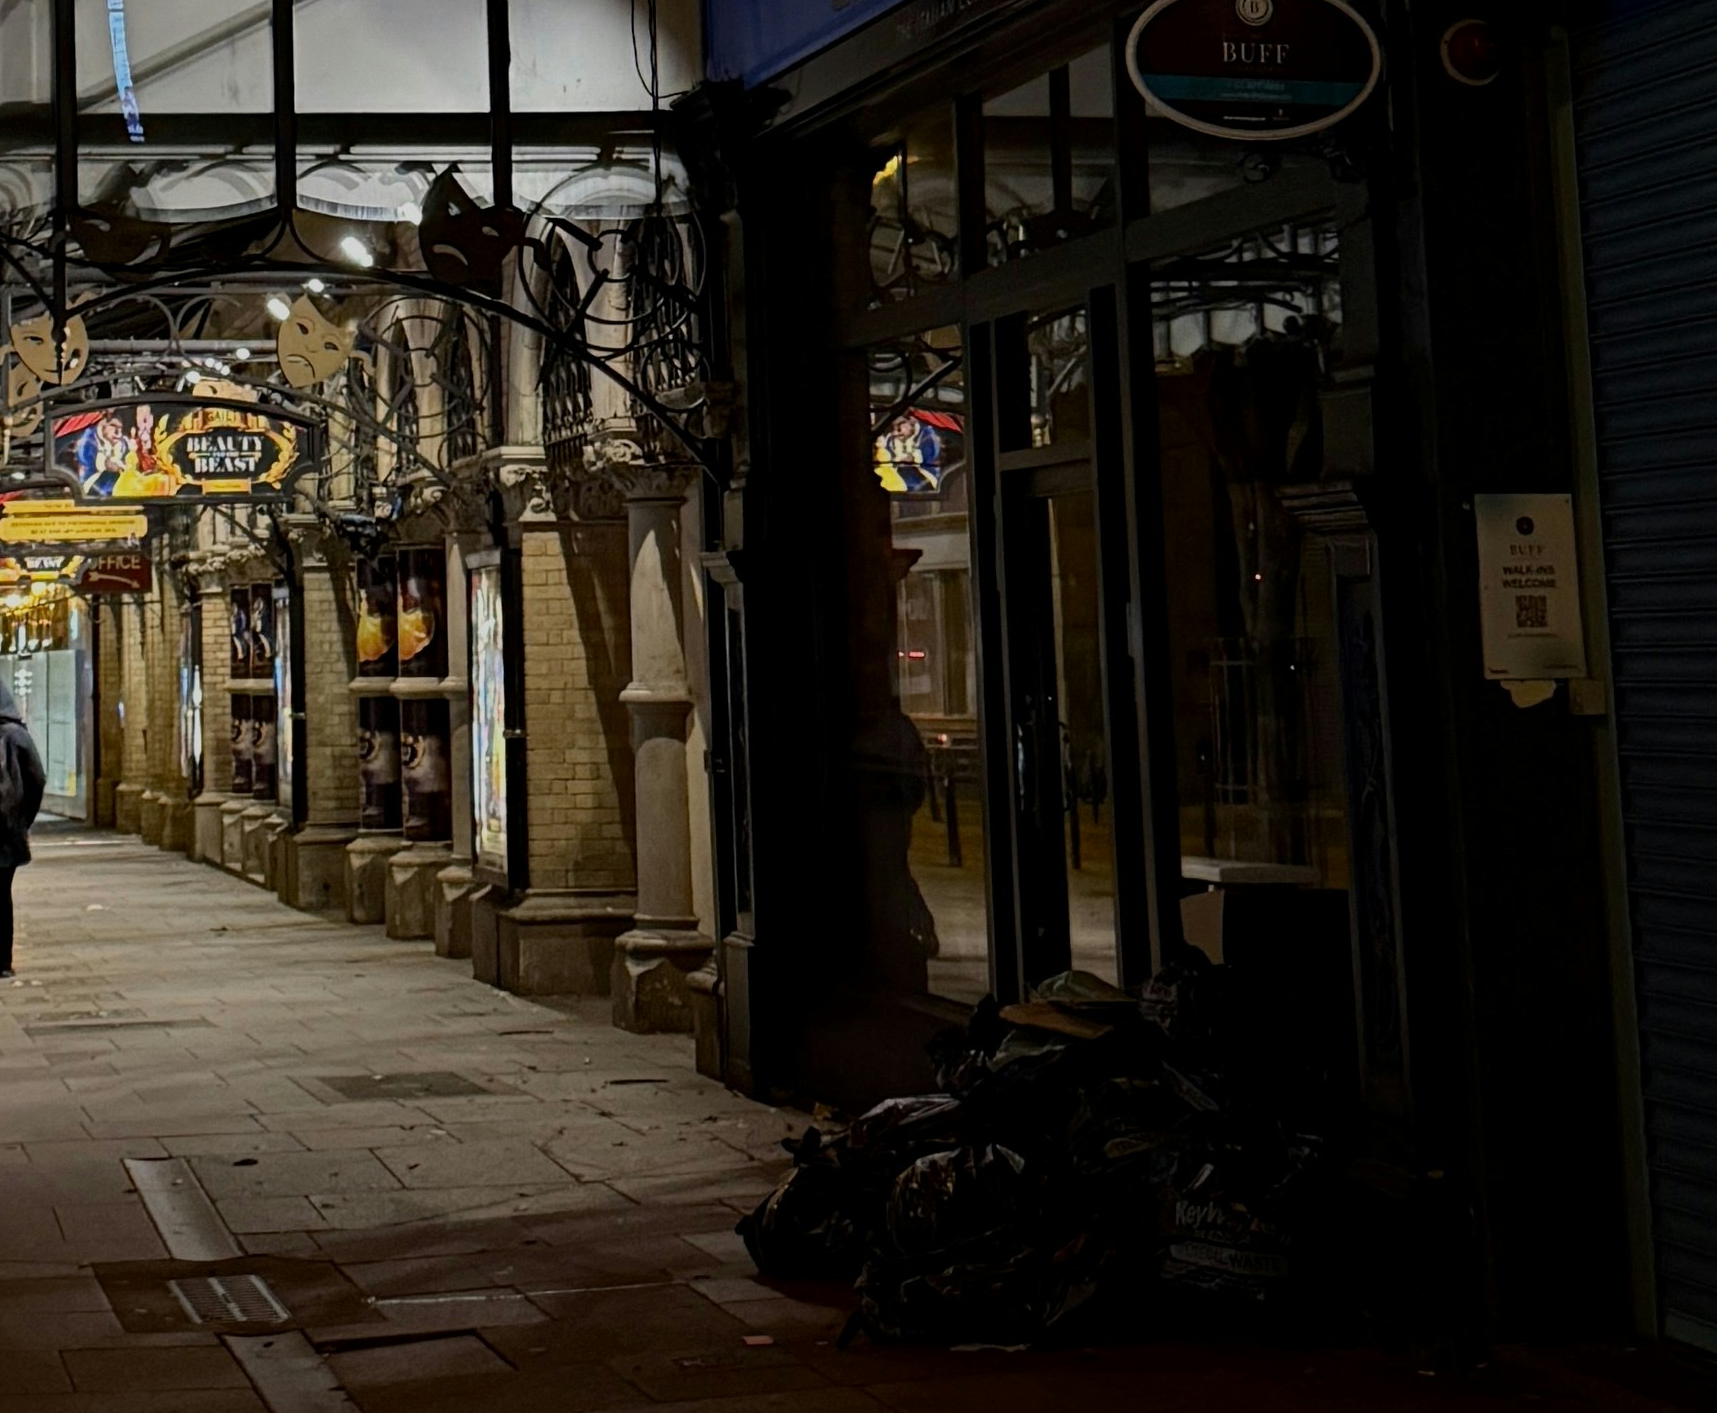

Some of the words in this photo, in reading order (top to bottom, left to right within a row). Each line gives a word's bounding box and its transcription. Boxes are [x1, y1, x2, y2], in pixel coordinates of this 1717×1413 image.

[1222, 40, 1291, 65] BUFF
[186, 436, 265, 452] BEAUTY
[194, 457, 257, 474] BEAST
[1502, 578, 1556, 589] WELCOME
